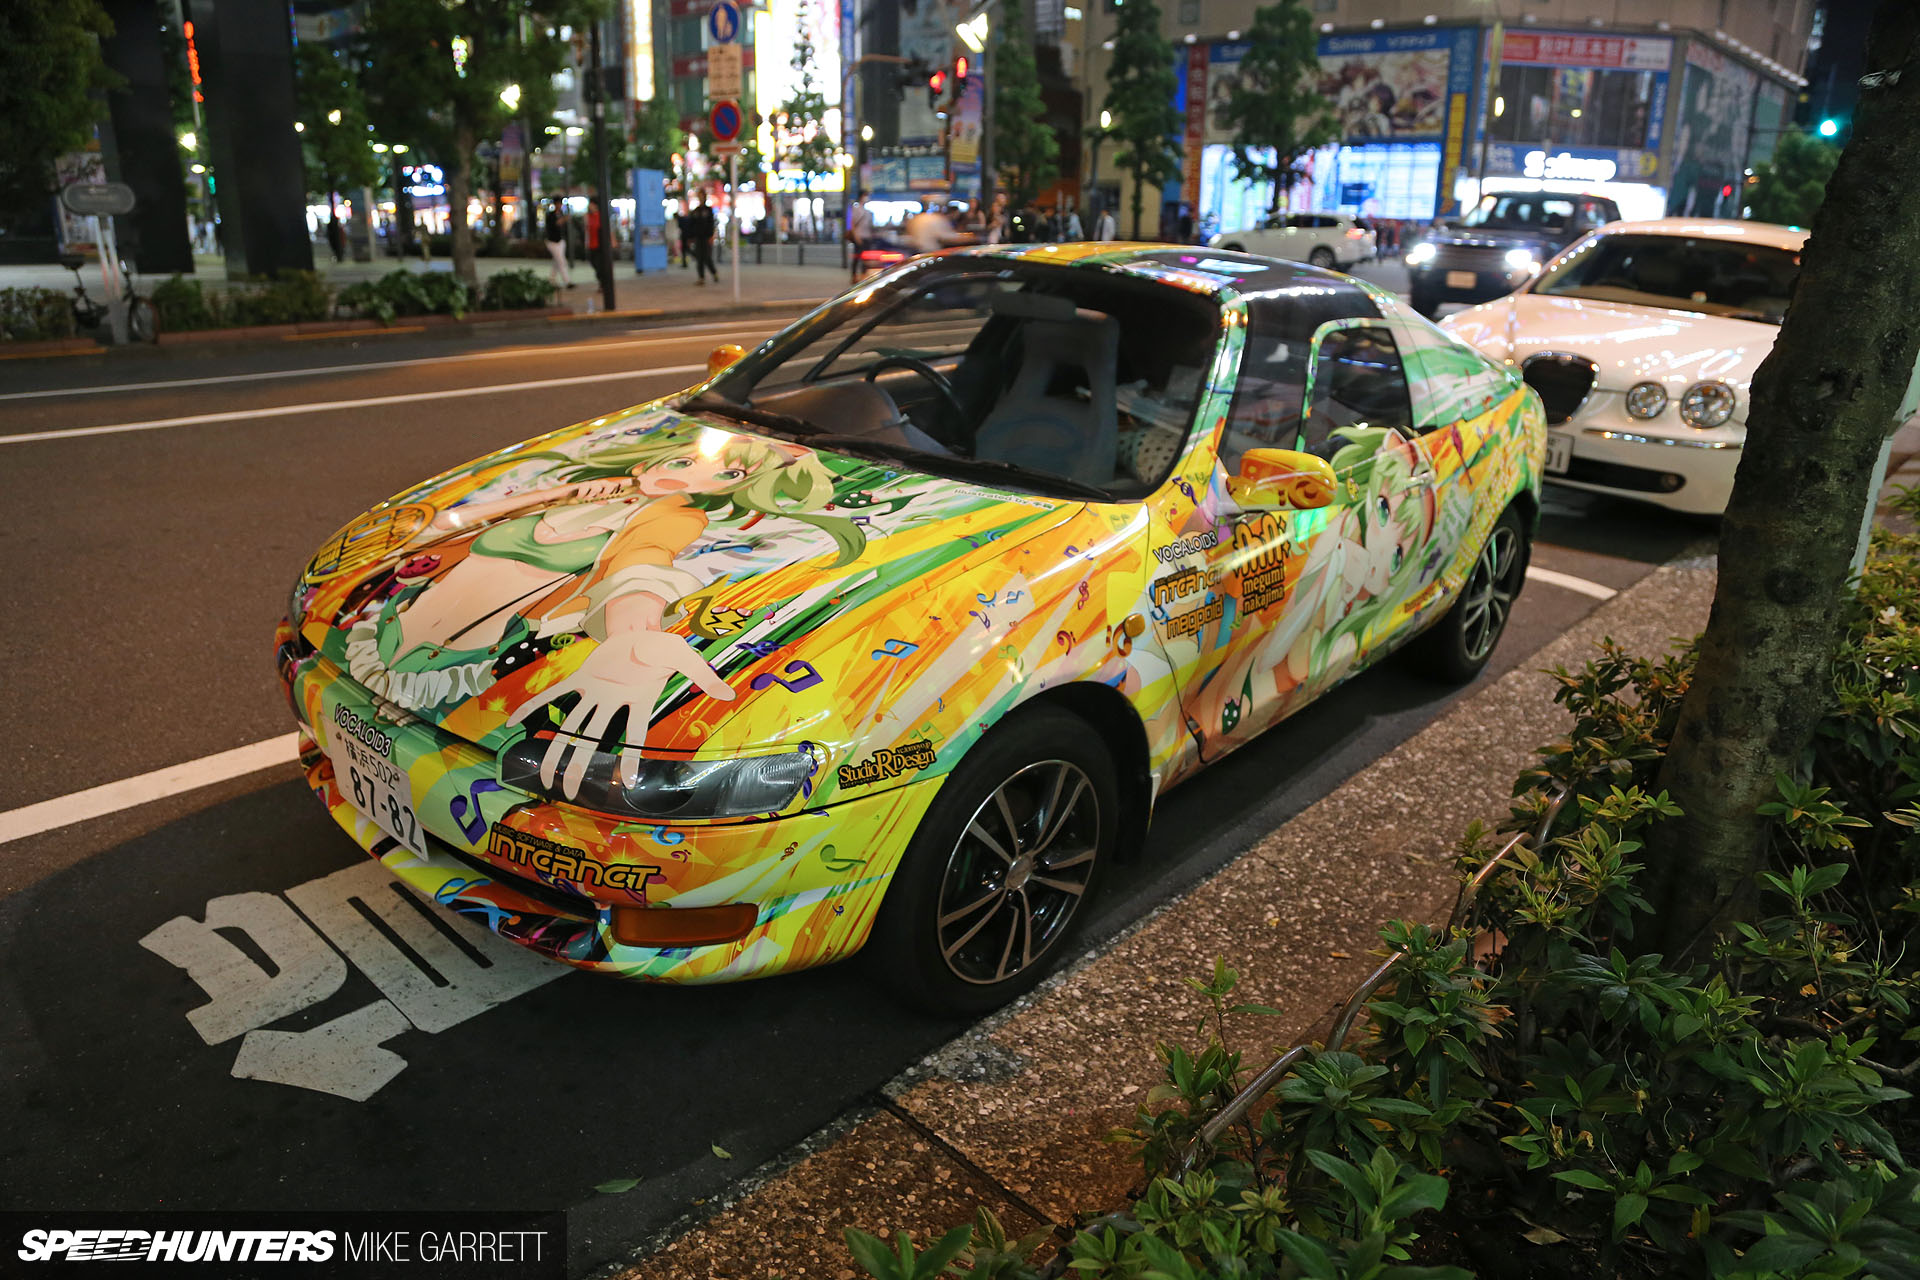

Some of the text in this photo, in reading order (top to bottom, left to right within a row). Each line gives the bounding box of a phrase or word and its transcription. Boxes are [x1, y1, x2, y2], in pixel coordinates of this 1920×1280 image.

[1153, 530, 1219, 564] VOCALOID3
[1242, 566, 1285, 597] megumi
[1242, 585, 1285, 615] nakajima
[334, 703, 393, 757] VOCALOID3
[350, 766, 422, 854] 87-82
[493, 823, 515, 839] MUSIC
[516, 831, 554, 850] SOFTWARE
[562, 846, 585, 859] DATA
[488, 830, 661, 891] INTERNET
